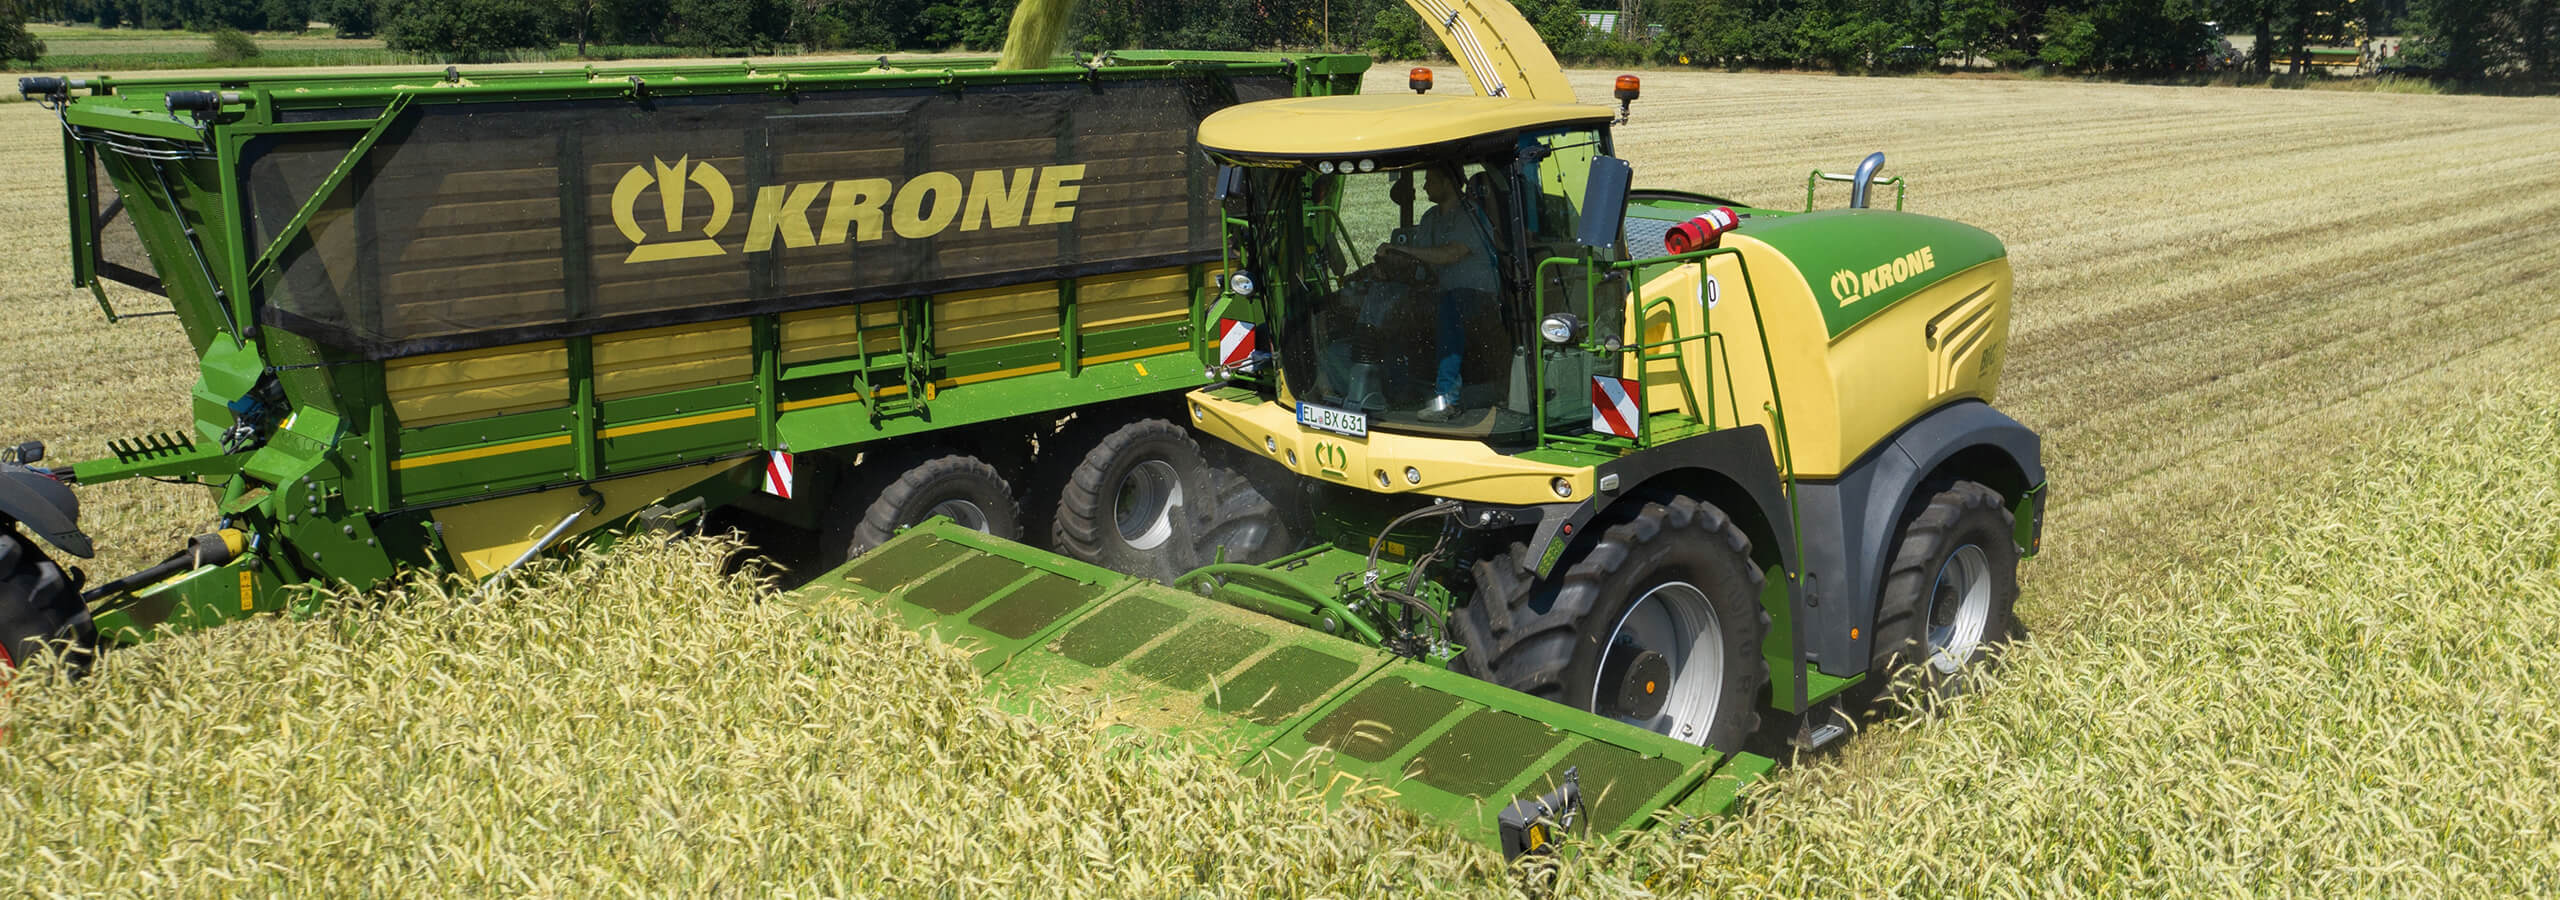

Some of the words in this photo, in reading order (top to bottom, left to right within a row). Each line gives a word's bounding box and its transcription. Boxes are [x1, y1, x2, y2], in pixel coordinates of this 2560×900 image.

[743, 163, 1086, 253] KRONE
[1861, 245, 1935, 297] KRONE
[1303, 406, 1317, 422] EL
[1324, 410, 1339, 428] BX
[1341, 414, 1364, 433] 631
